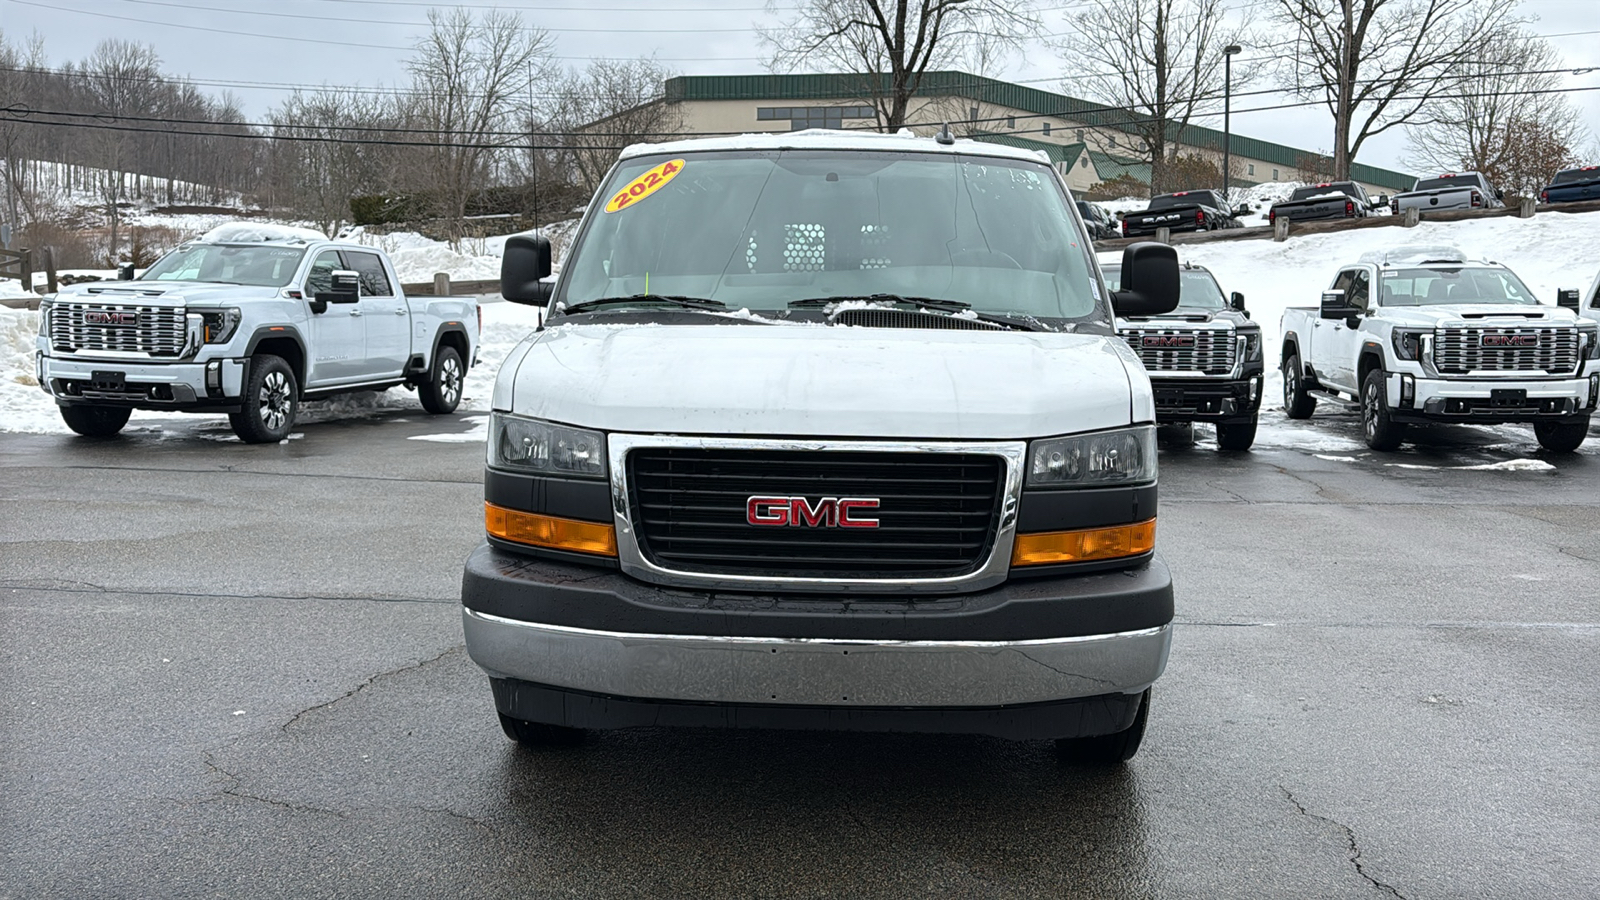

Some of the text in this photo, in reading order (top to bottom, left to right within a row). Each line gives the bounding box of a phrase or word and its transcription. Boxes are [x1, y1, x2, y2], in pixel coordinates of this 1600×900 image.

[614, 162, 678, 209] 2024
[1142, 214, 1180, 224] RAM
[85, 312, 136, 324] GMC
[1143, 336, 1194, 347] GMC
[1483, 335, 1537, 346] GMC
[747, 495, 880, 528] GMC
